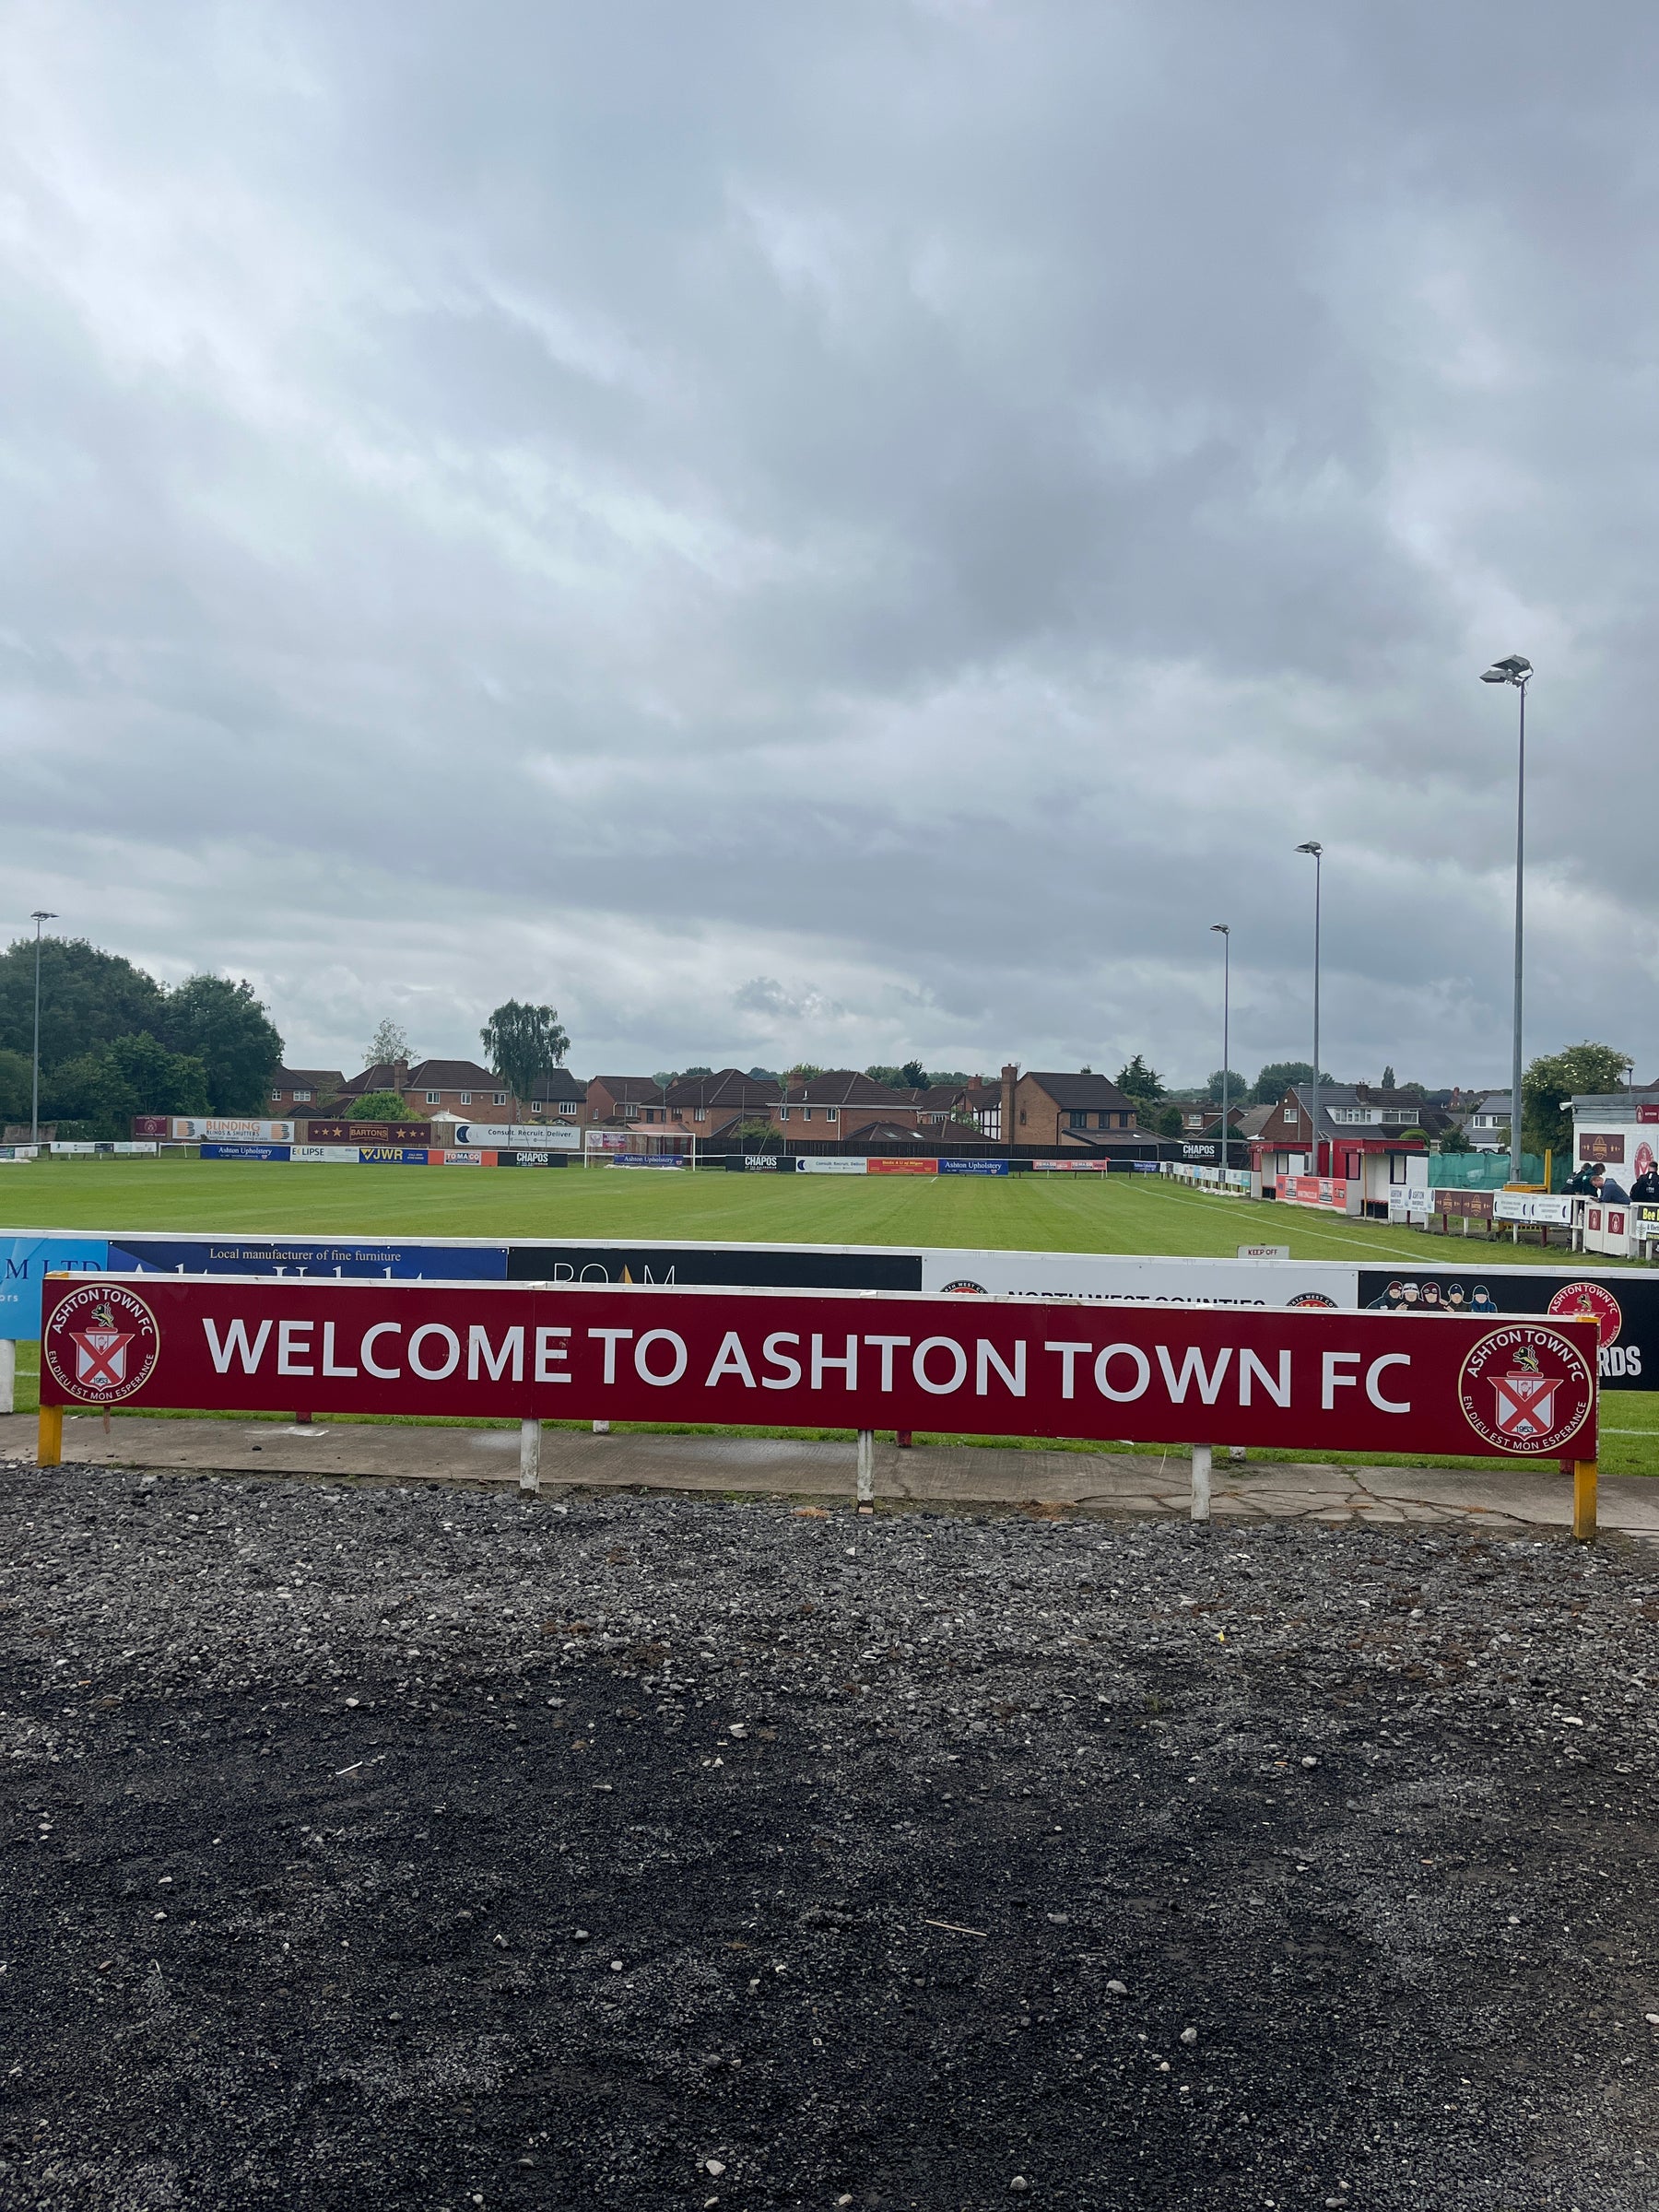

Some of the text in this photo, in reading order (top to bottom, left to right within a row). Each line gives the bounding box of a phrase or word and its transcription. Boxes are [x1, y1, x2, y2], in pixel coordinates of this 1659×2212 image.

[206, 1120, 261, 1132] BLINDING
[240, 1147, 273, 1156] Upholstery
[372, 1148, 404, 1160] JWR
[1182, 1145, 1215, 1155] CHAPOS
[516, 1152, 548, 1162] CHAPOS
[745, 1156, 777, 1166] CHAPOS
[968, 1162, 1002, 1171] Upholstery
[1642, 1207, 1655, 1220] Bee
[209, 1248, 402, 1262] Local manufacturer of fine furniture
[1551, 1285, 1618, 1314] ASHTON TOWN FC
[52, 1288, 153, 1336] ASHTON TOWN FC
[1466, 1330, 1584, 1382] ASHTON TOWN FC
[202, 1318, 1411, 1414] WELCOME TO ASHTON TOWN FC
[48, 1350, 154, 1400] EN DIEU EST MON ESPERANCE
[1463, 1395, 1587, 1451] EN DIEU EST MON ESPERANCE
